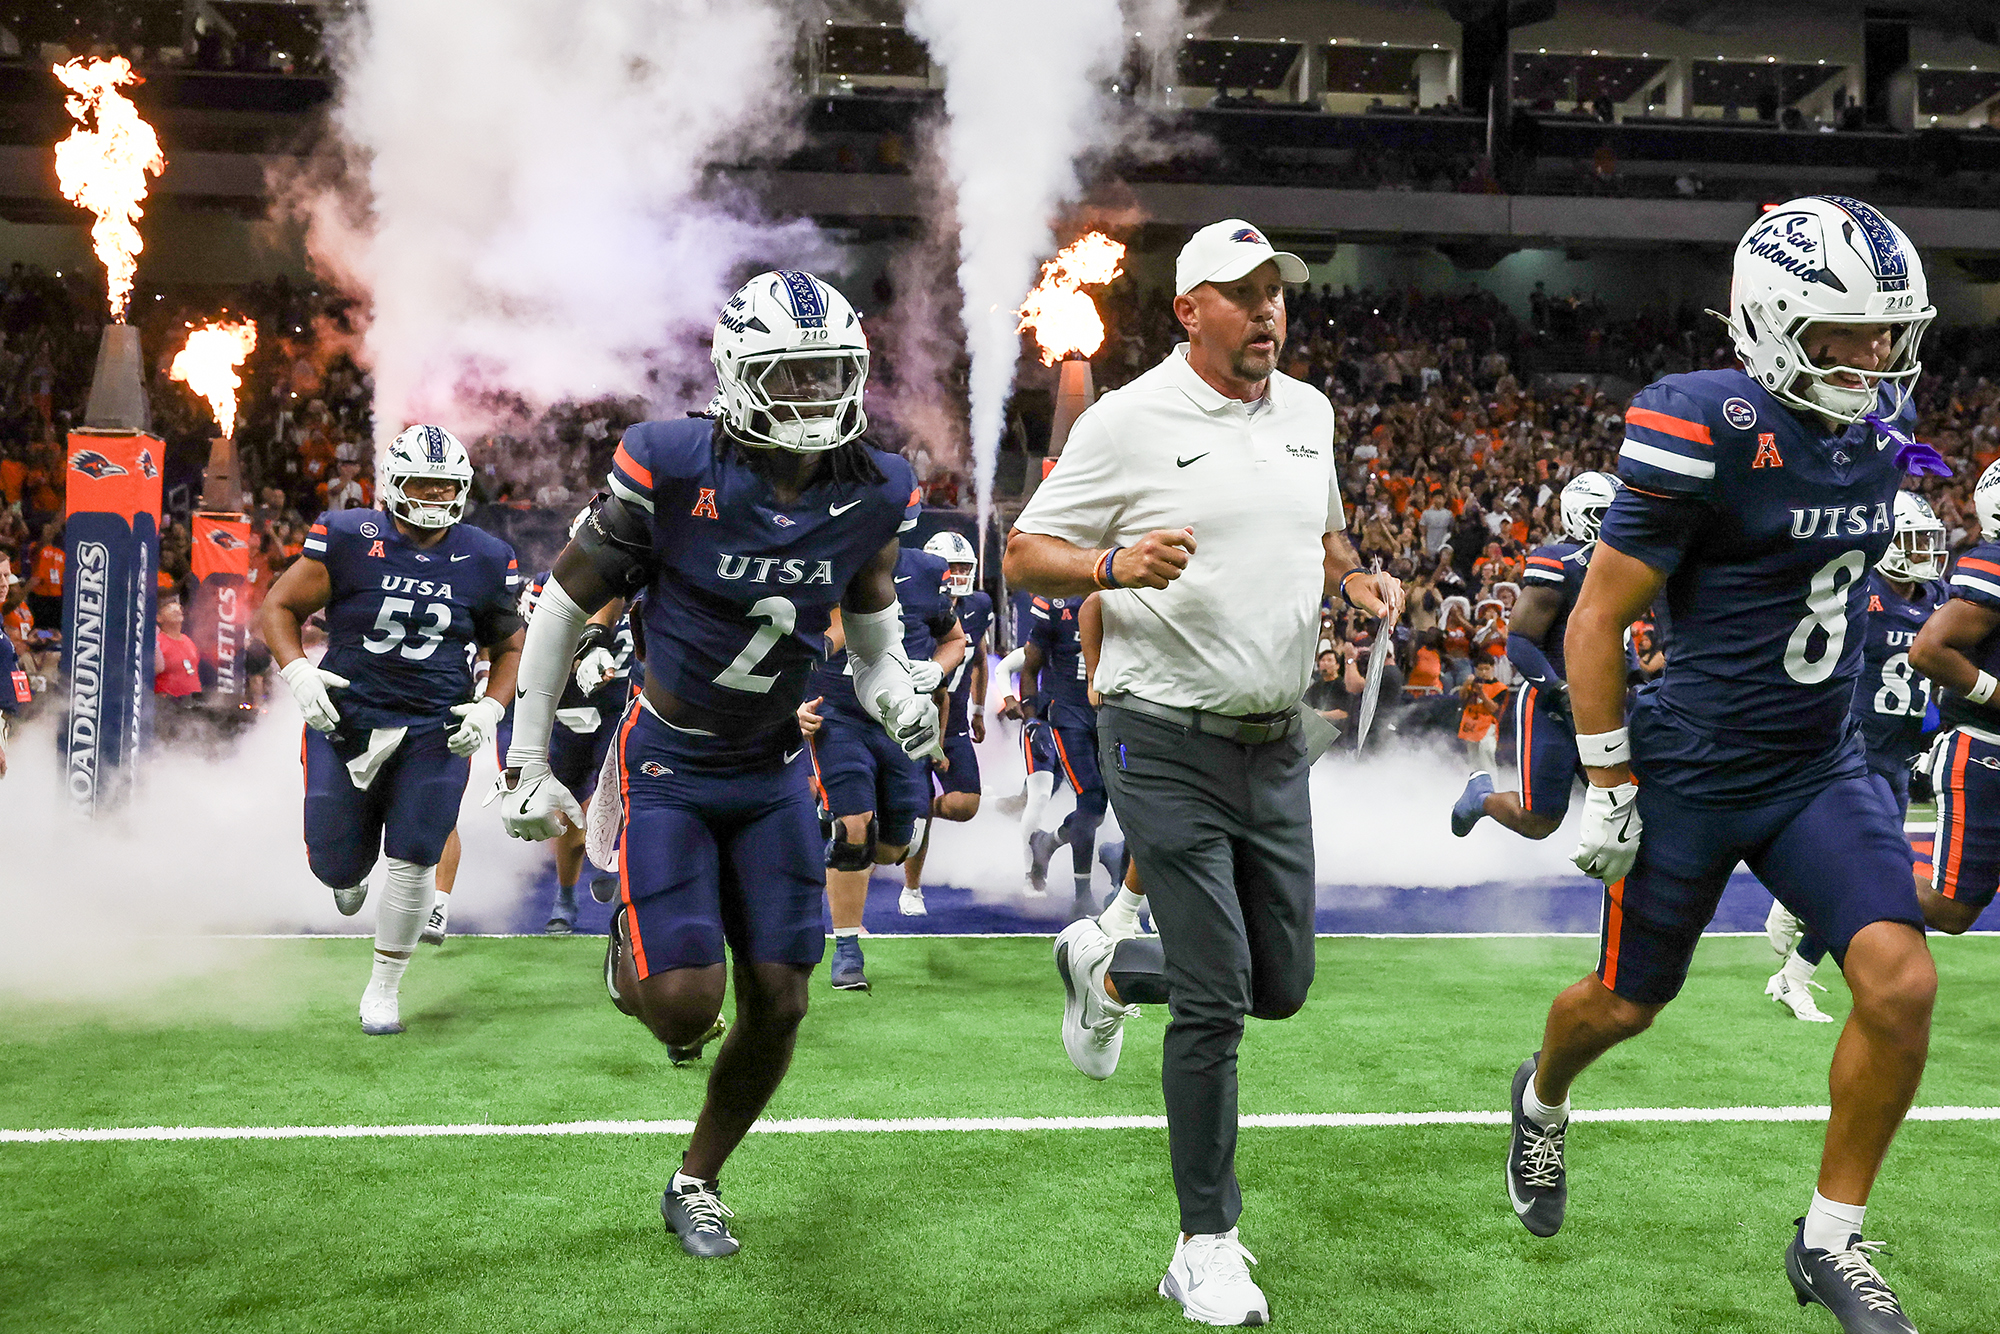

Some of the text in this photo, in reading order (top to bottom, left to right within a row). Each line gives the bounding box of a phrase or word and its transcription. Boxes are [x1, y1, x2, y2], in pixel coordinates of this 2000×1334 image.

[1774, 217, 1817, 253] San
[1742, 224, 1820, 283] Antonio
[1885, 295, 1913, 310] 210
[801, 330, 828, 341] 210
[1790, 503, 1890, 539] UTSA
[716, 552, 834, 585] UTSA
[381, 574, 453, 600] UTSA
[362, 596, 452, 660] 53
[1783, 549, 1866, 684] 8
[712, 596, 797, 694] 2
[1886, 630, 1917, 647] UT
